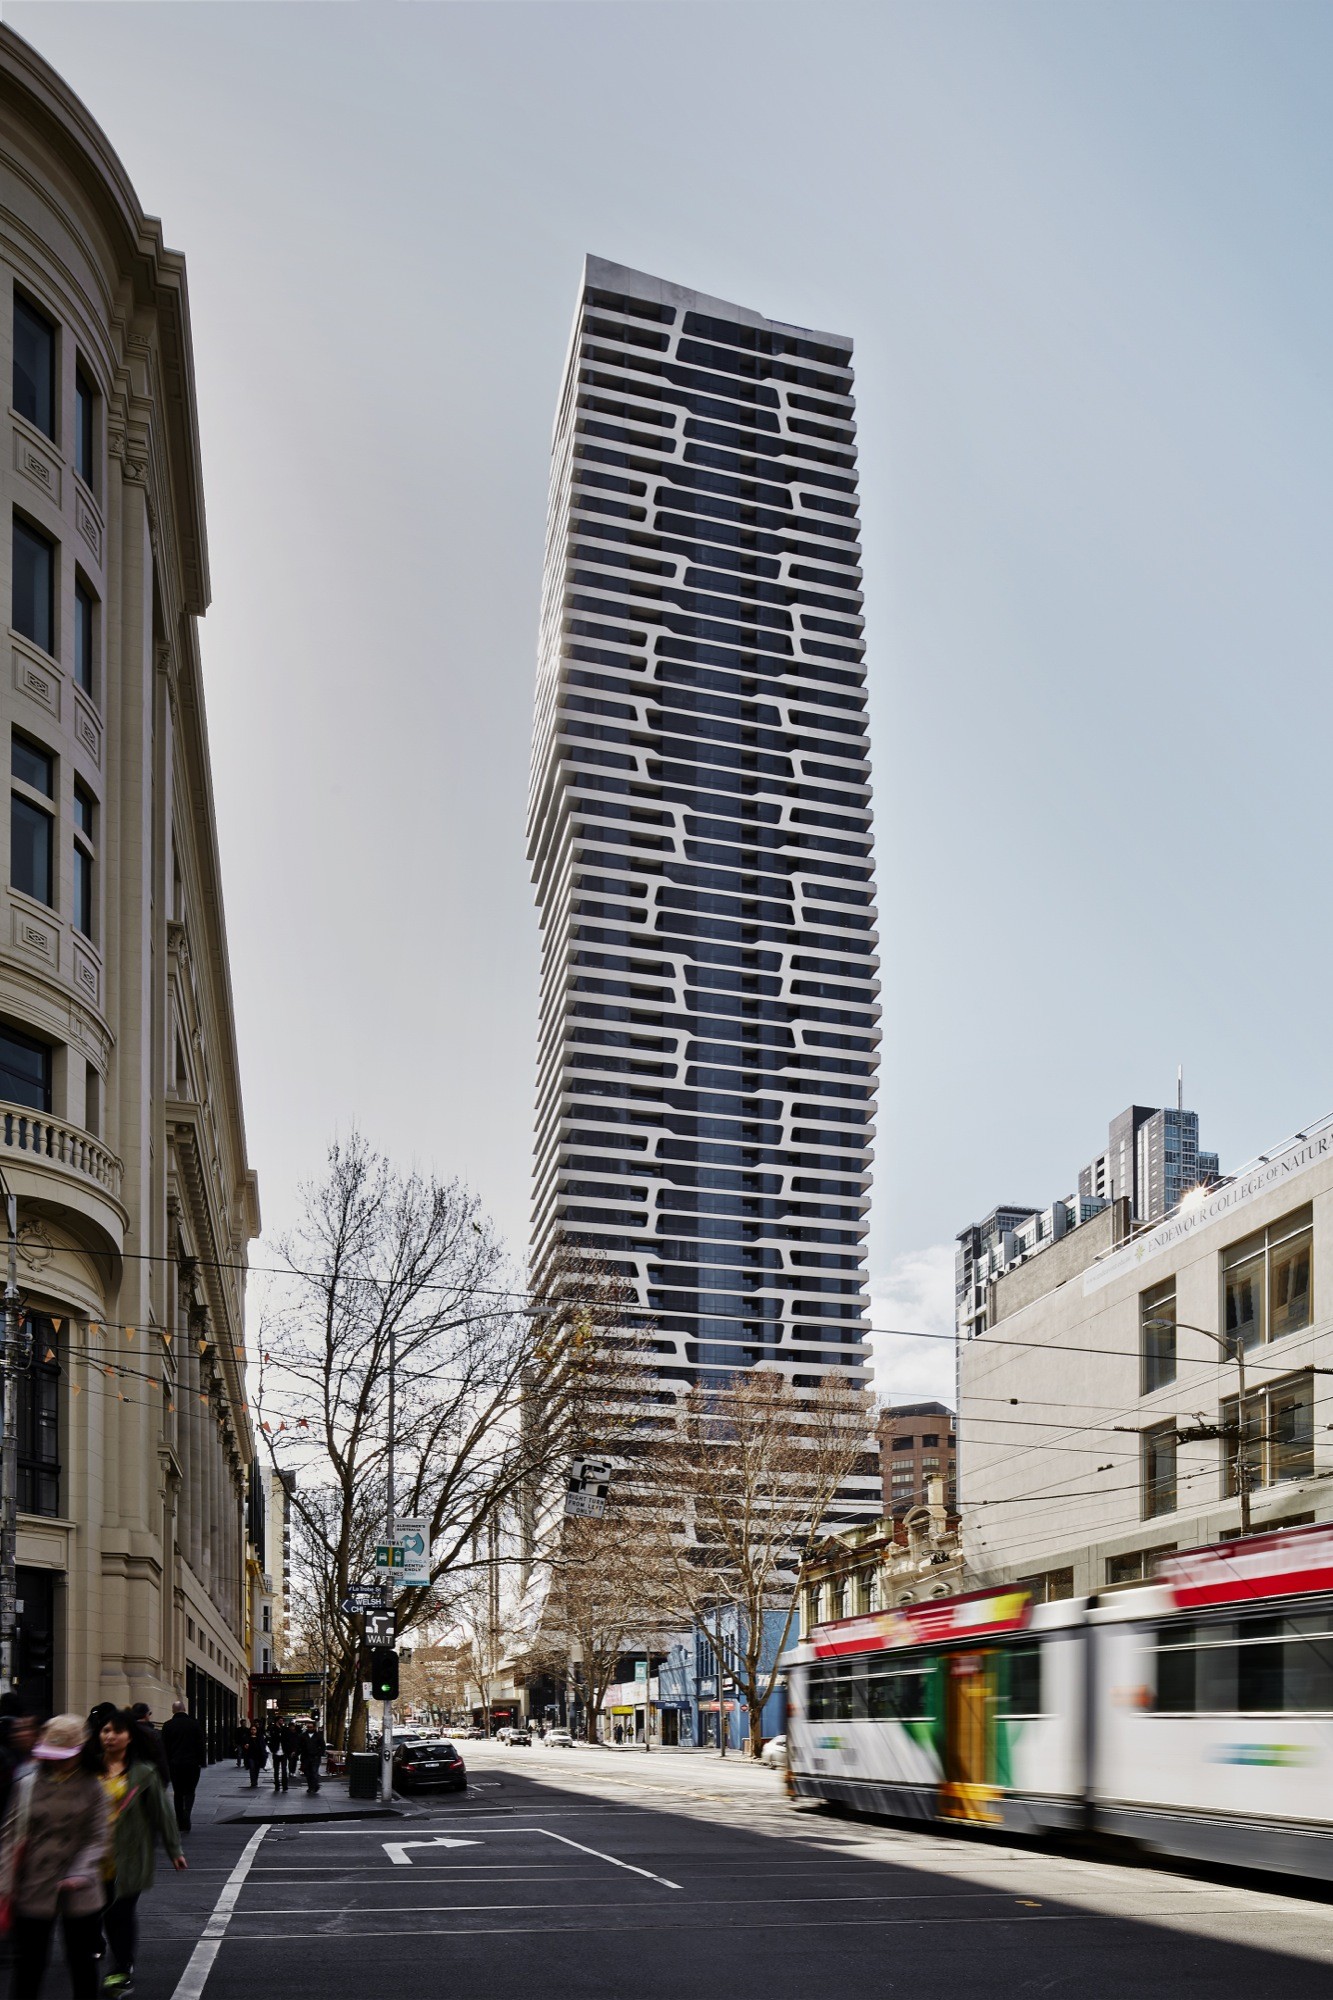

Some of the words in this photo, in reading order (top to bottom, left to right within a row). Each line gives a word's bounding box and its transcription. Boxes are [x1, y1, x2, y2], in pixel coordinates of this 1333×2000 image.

[1148, 1208, 1207, 1253] ENDEAVOUR
[1209, 1173, 1265, 1217] COLLEGE
[1266, 1164, 1280, 1181] OF
[576, 1507, 592, 1515] ONLY
[355, 1598, 382, 1606] WELSH
[367, 1634, 393, 1645] WAIT
